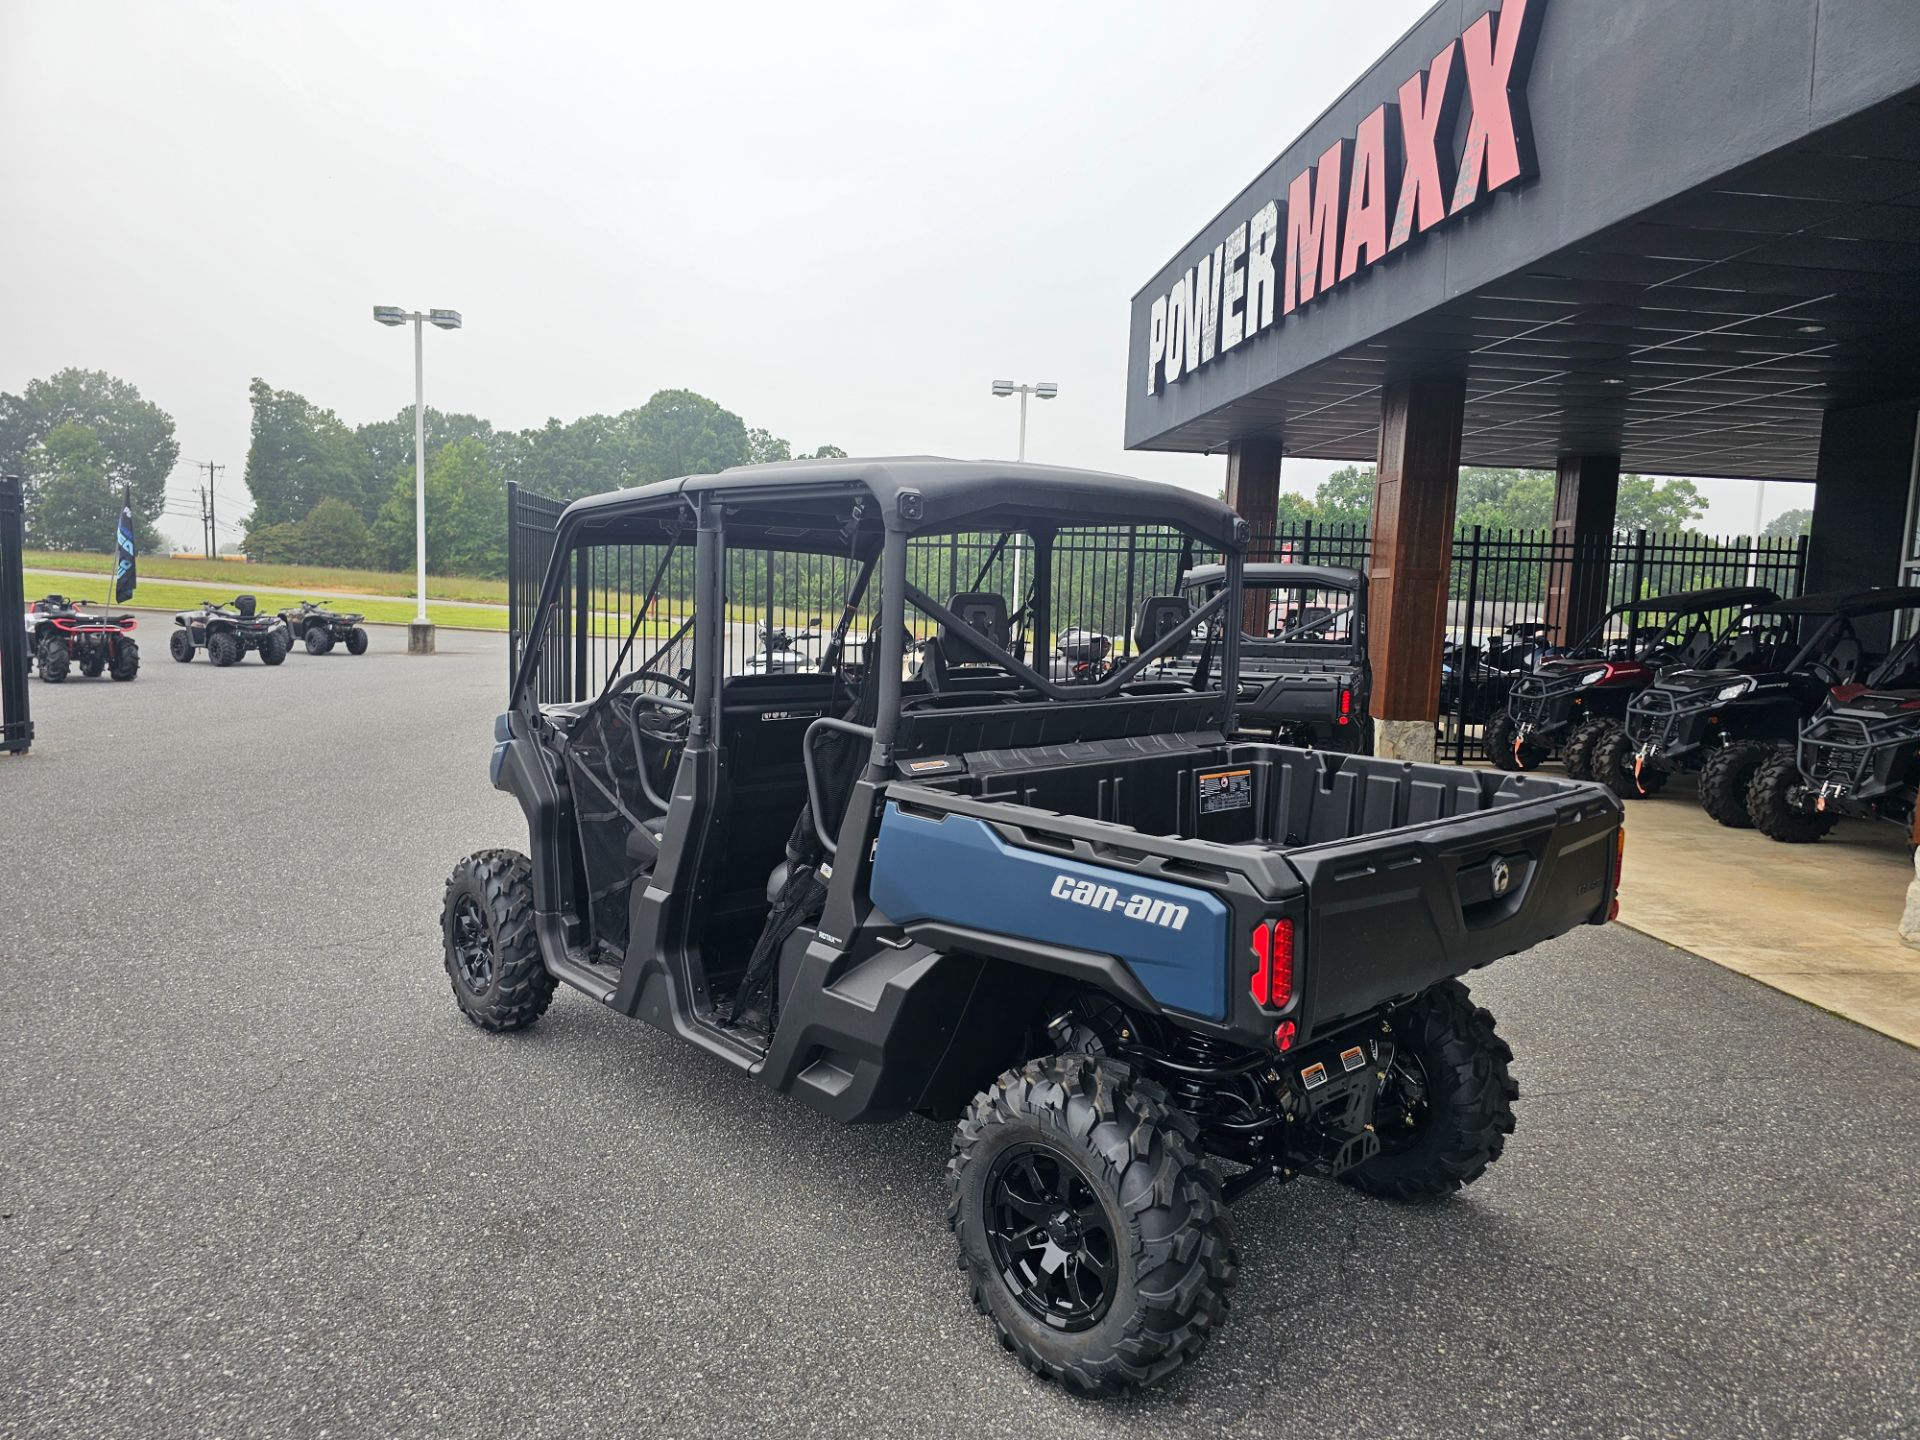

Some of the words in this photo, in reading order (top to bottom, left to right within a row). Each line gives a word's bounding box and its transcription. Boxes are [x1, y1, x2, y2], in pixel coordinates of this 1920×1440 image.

[1147, 199, 1279, 396] POWER
[1283, 0, 1528, 315] MAXX
[1050, 874, 1189, 930] can-am
